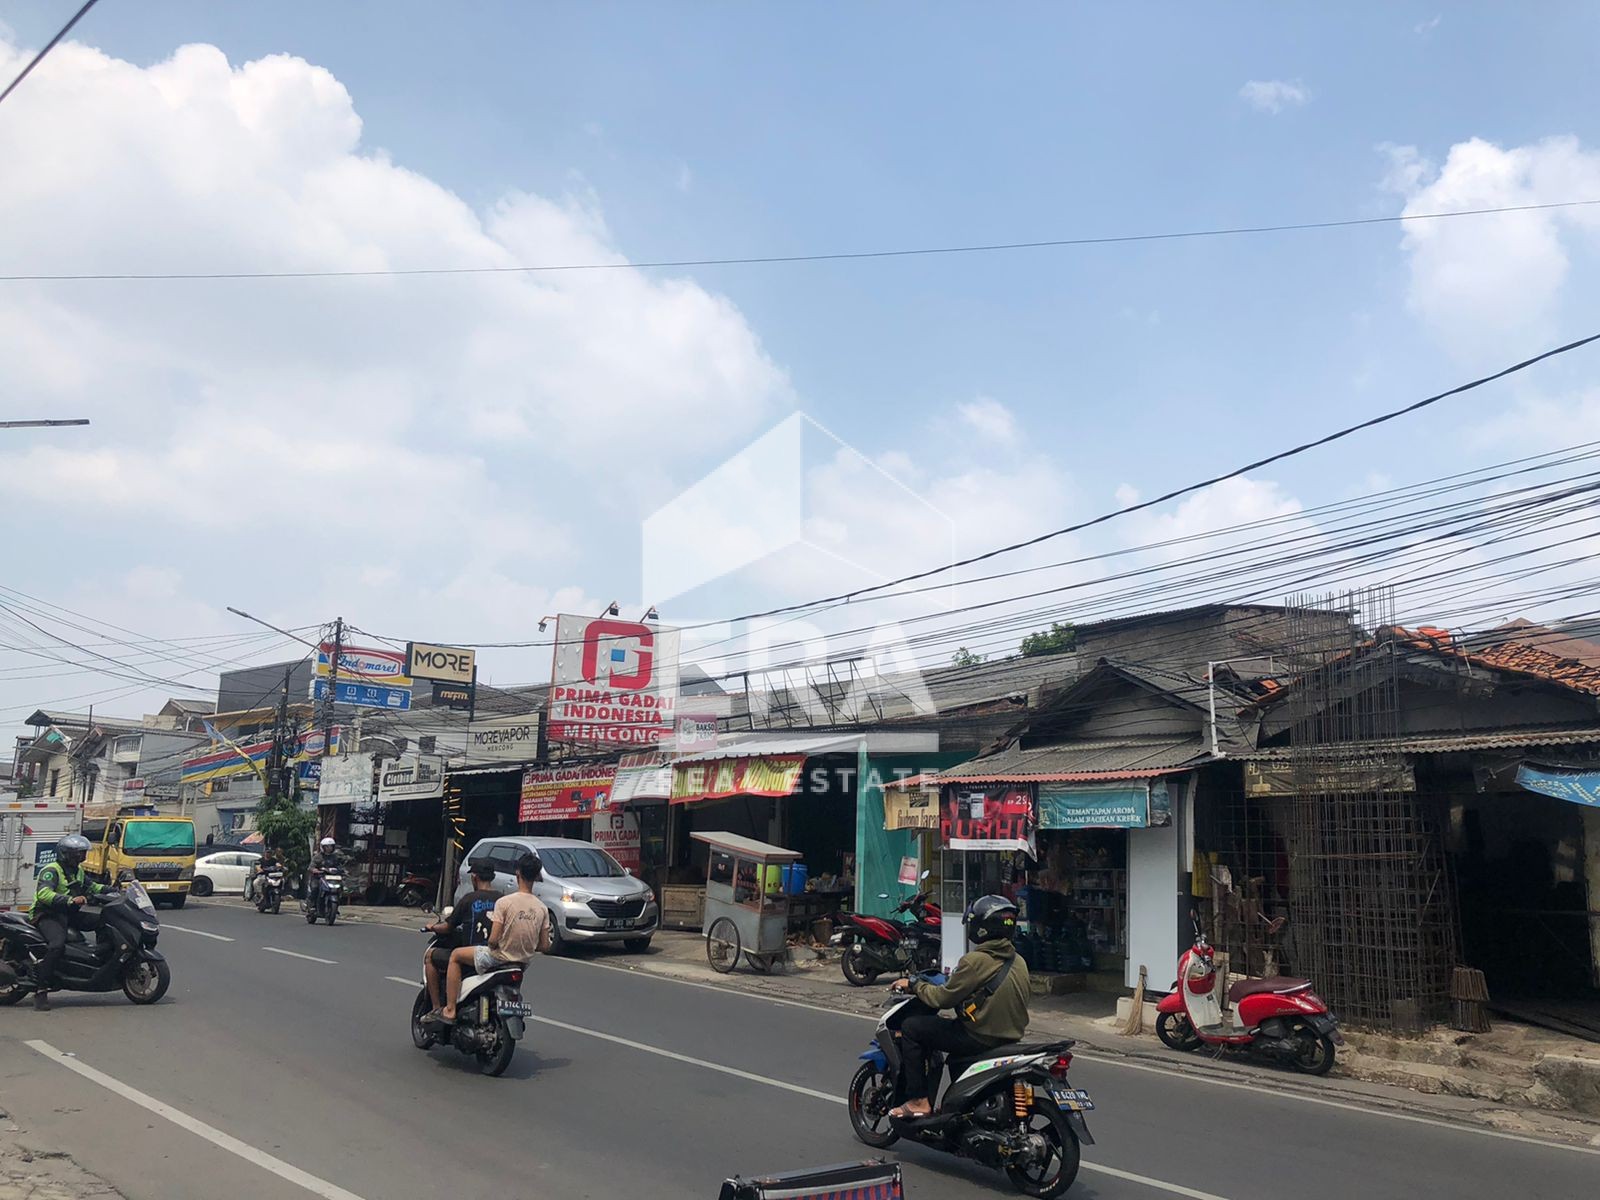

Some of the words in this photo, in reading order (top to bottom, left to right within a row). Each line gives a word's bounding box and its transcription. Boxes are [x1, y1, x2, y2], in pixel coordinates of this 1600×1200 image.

[338, 654, 398, 674] Indomaret
[415, 650, 470, 672] MORE
[554, 687, 613, 705] PRIMA
[619, 693, 673, 710] GADAI
[563, 703, 663, 724] INDONESIA
[564, 724, 660, 743] MENCONG
[531, 771, 554, 785] PRIMA
[555, 769, 580, 782] GADAI
[1062, 815, 1085, 824] DALAM
[1067, 806, 1112, 816] KEMANTAPAN
[594, 830, 617, 841] PRIMA
[619, 830, 639, 841] GADAI
